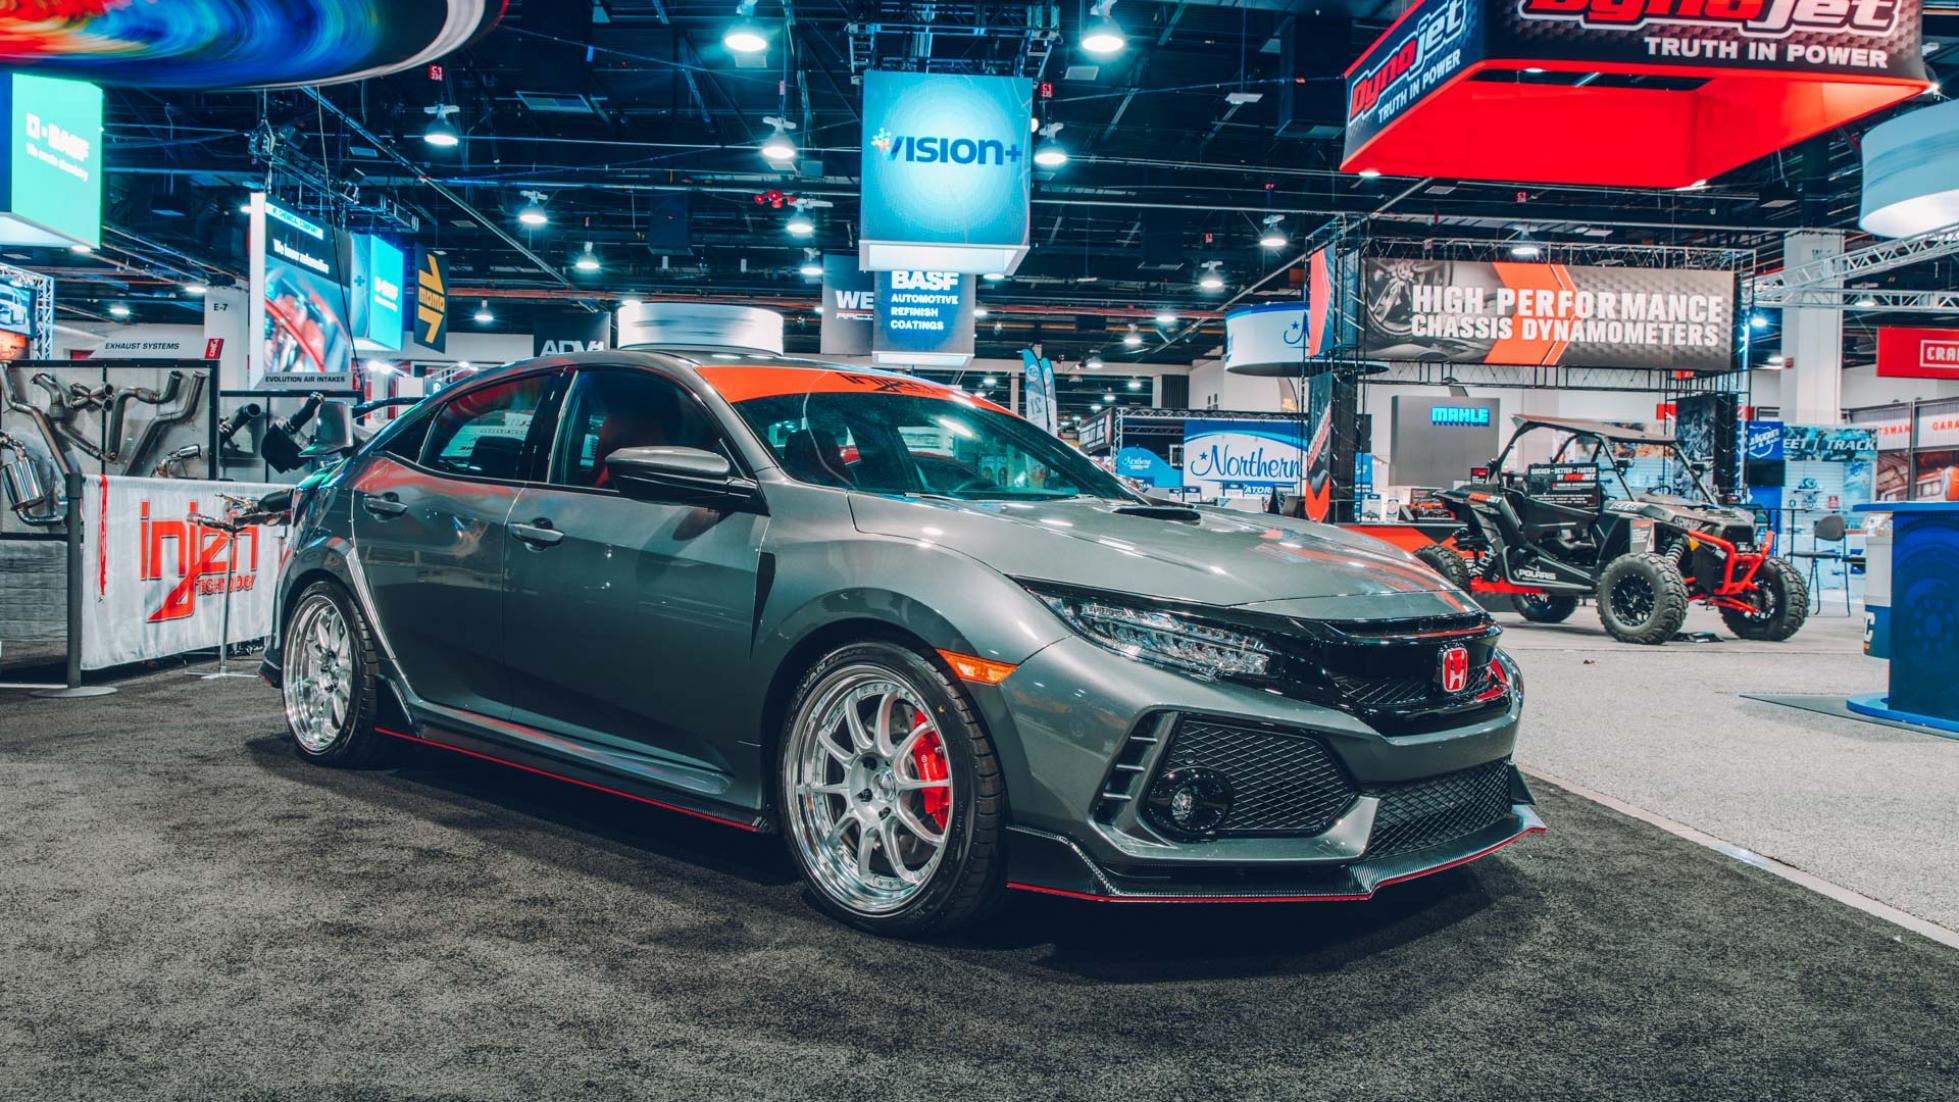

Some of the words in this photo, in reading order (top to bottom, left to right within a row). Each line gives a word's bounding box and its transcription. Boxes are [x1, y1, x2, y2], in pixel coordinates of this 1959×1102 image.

[1350, 0, 1462, 118] Dynojet
[1644, 37, 1738, 60] TRUTH
[1748, 42, 1777, 61] IN
[1786, 44, 1888, 69] POWER
[1378, 88, 1408, 123] TRUTH
[1409, 78, 1420, 100] IN
[1422, 49, 1461, 90] POWER
[891, 270, 959, 291] BASF
[890, 293, 958, 305] AUTOMOTIVE
[1412, 285, 1484, 314] HIGH
[1497, 288, 1724, 323] PERFORMANCE
[213, 303, 228, 312] E-7
[890, 307, 938, 317] REFINISH
[890, 320, 944, 330] COATINGS
[1411, 314, 1513, 340] CHASSIS
[1522, 318, 1720, 347] DYNAMOMETERS
[105, 342, 140, 350] EXHAUST
[142, 342, 180, 350] SYSTEMS
[1926, 346, 1959, 361] CRA
[1432, 407, 1489, 423] MAHLE
[1826, 439, 1876, 451] TRACK
[1190, 445, 1301, 478] Northern
